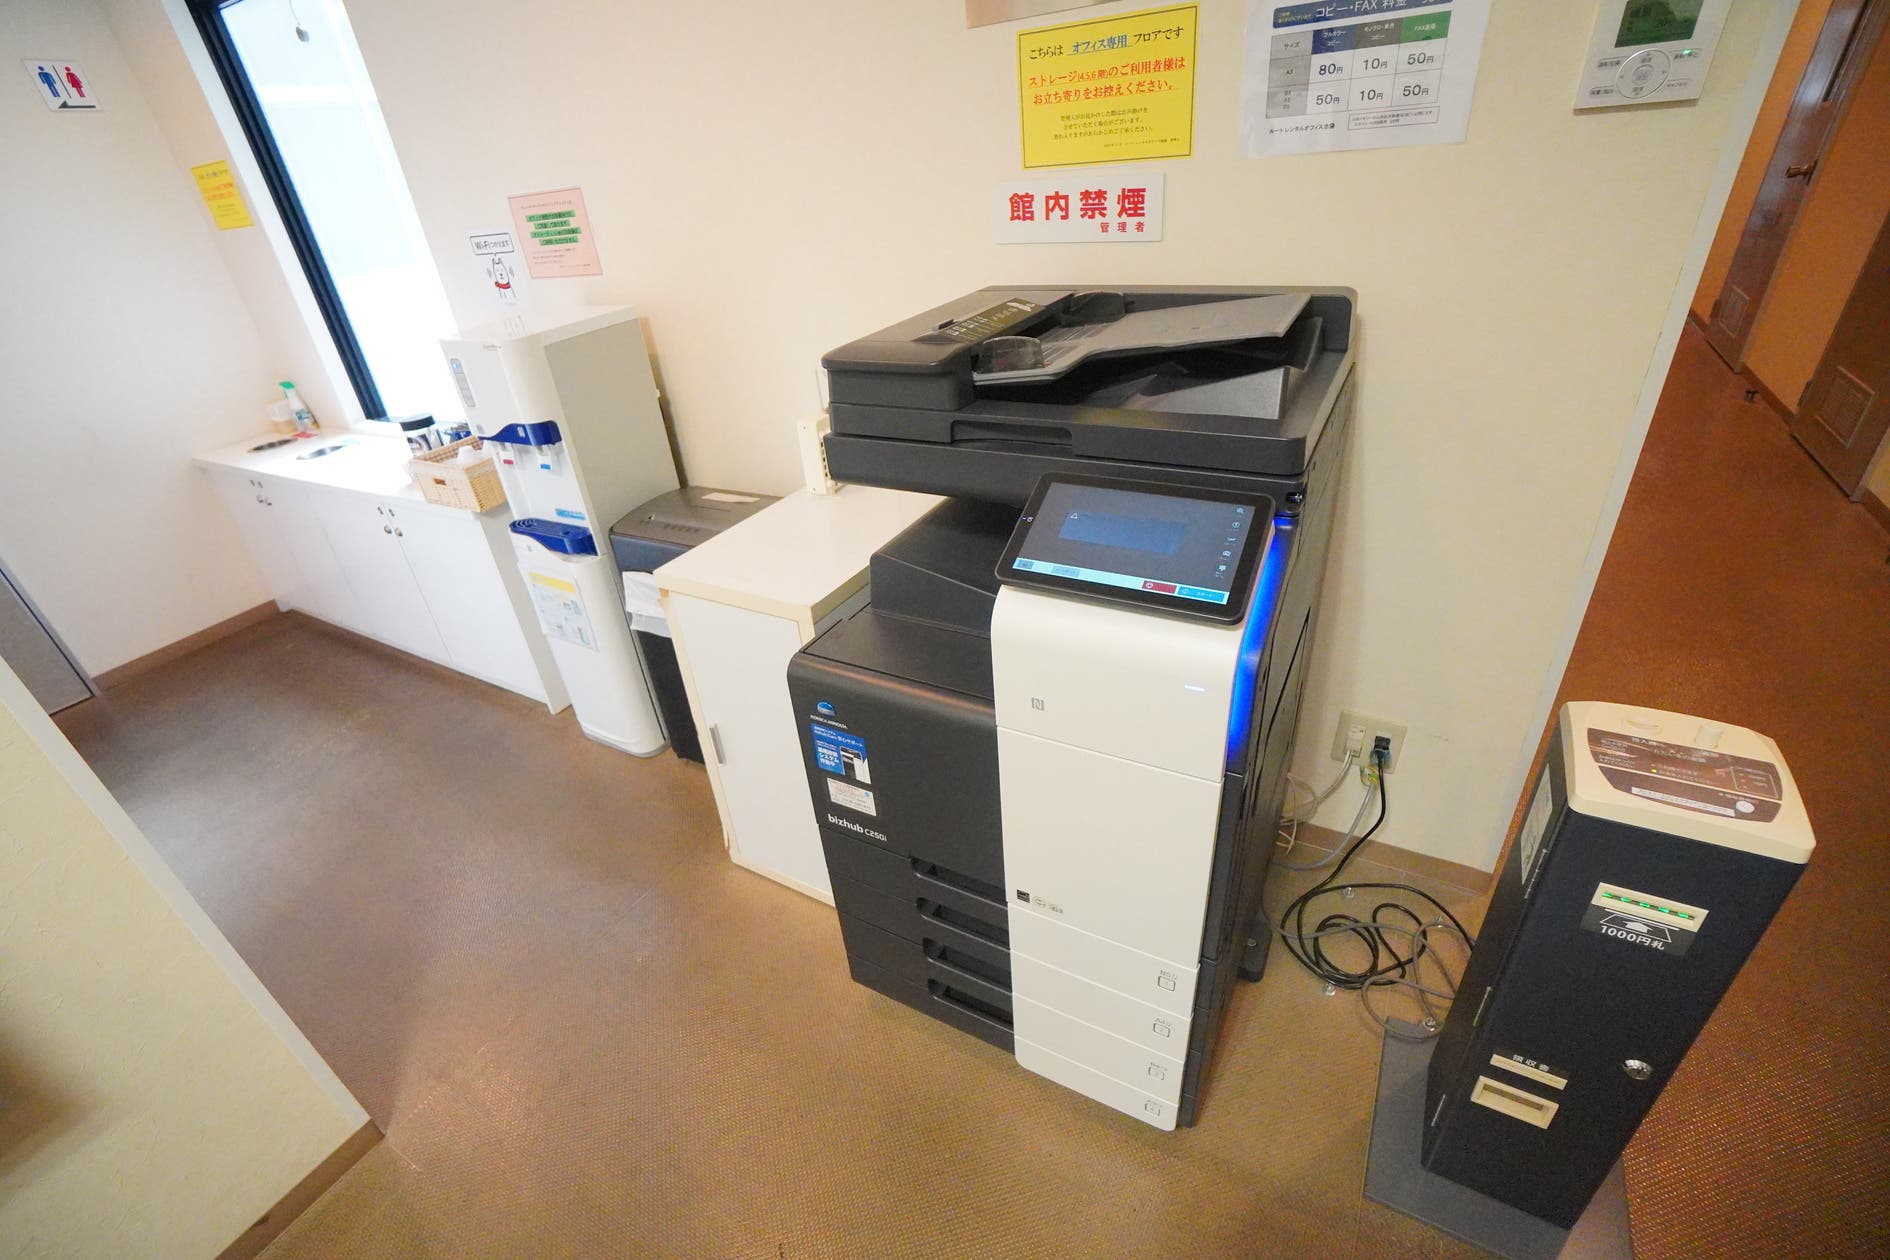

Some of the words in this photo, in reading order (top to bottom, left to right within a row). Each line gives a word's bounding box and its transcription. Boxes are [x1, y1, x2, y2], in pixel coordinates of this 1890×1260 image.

[1029, 44, 1063, 60] こちらは
[1072, 34, 1127, 53] オフィス専用
[1133, 26, 1184, 44] フロアです
[1284, 41, 1300, 50] サイズ
[1322, 30, 1346, 38] フルカラー
[1318, 63, 1343, 76] 80円
[1363, 57, 1388, 70] 10円
[1407, 52, 1434, 65] 50円
[1033, 79, 1173, 105] お立ち寄りをお控えください。
[1316, 93, 1340, 106] 50円
[1359, 89, 1384, 101] 10円
[1402, 84, 1429, 97] 50円
[1009, 187, 1147, 222] 館内禁煙
[1100, 221, 1145, 233] 管理者
[828, 813, 864, 833] bizhub
[864, 828, 888, 842] C250i
[1601, 925, 1665, 950] 1000円札
